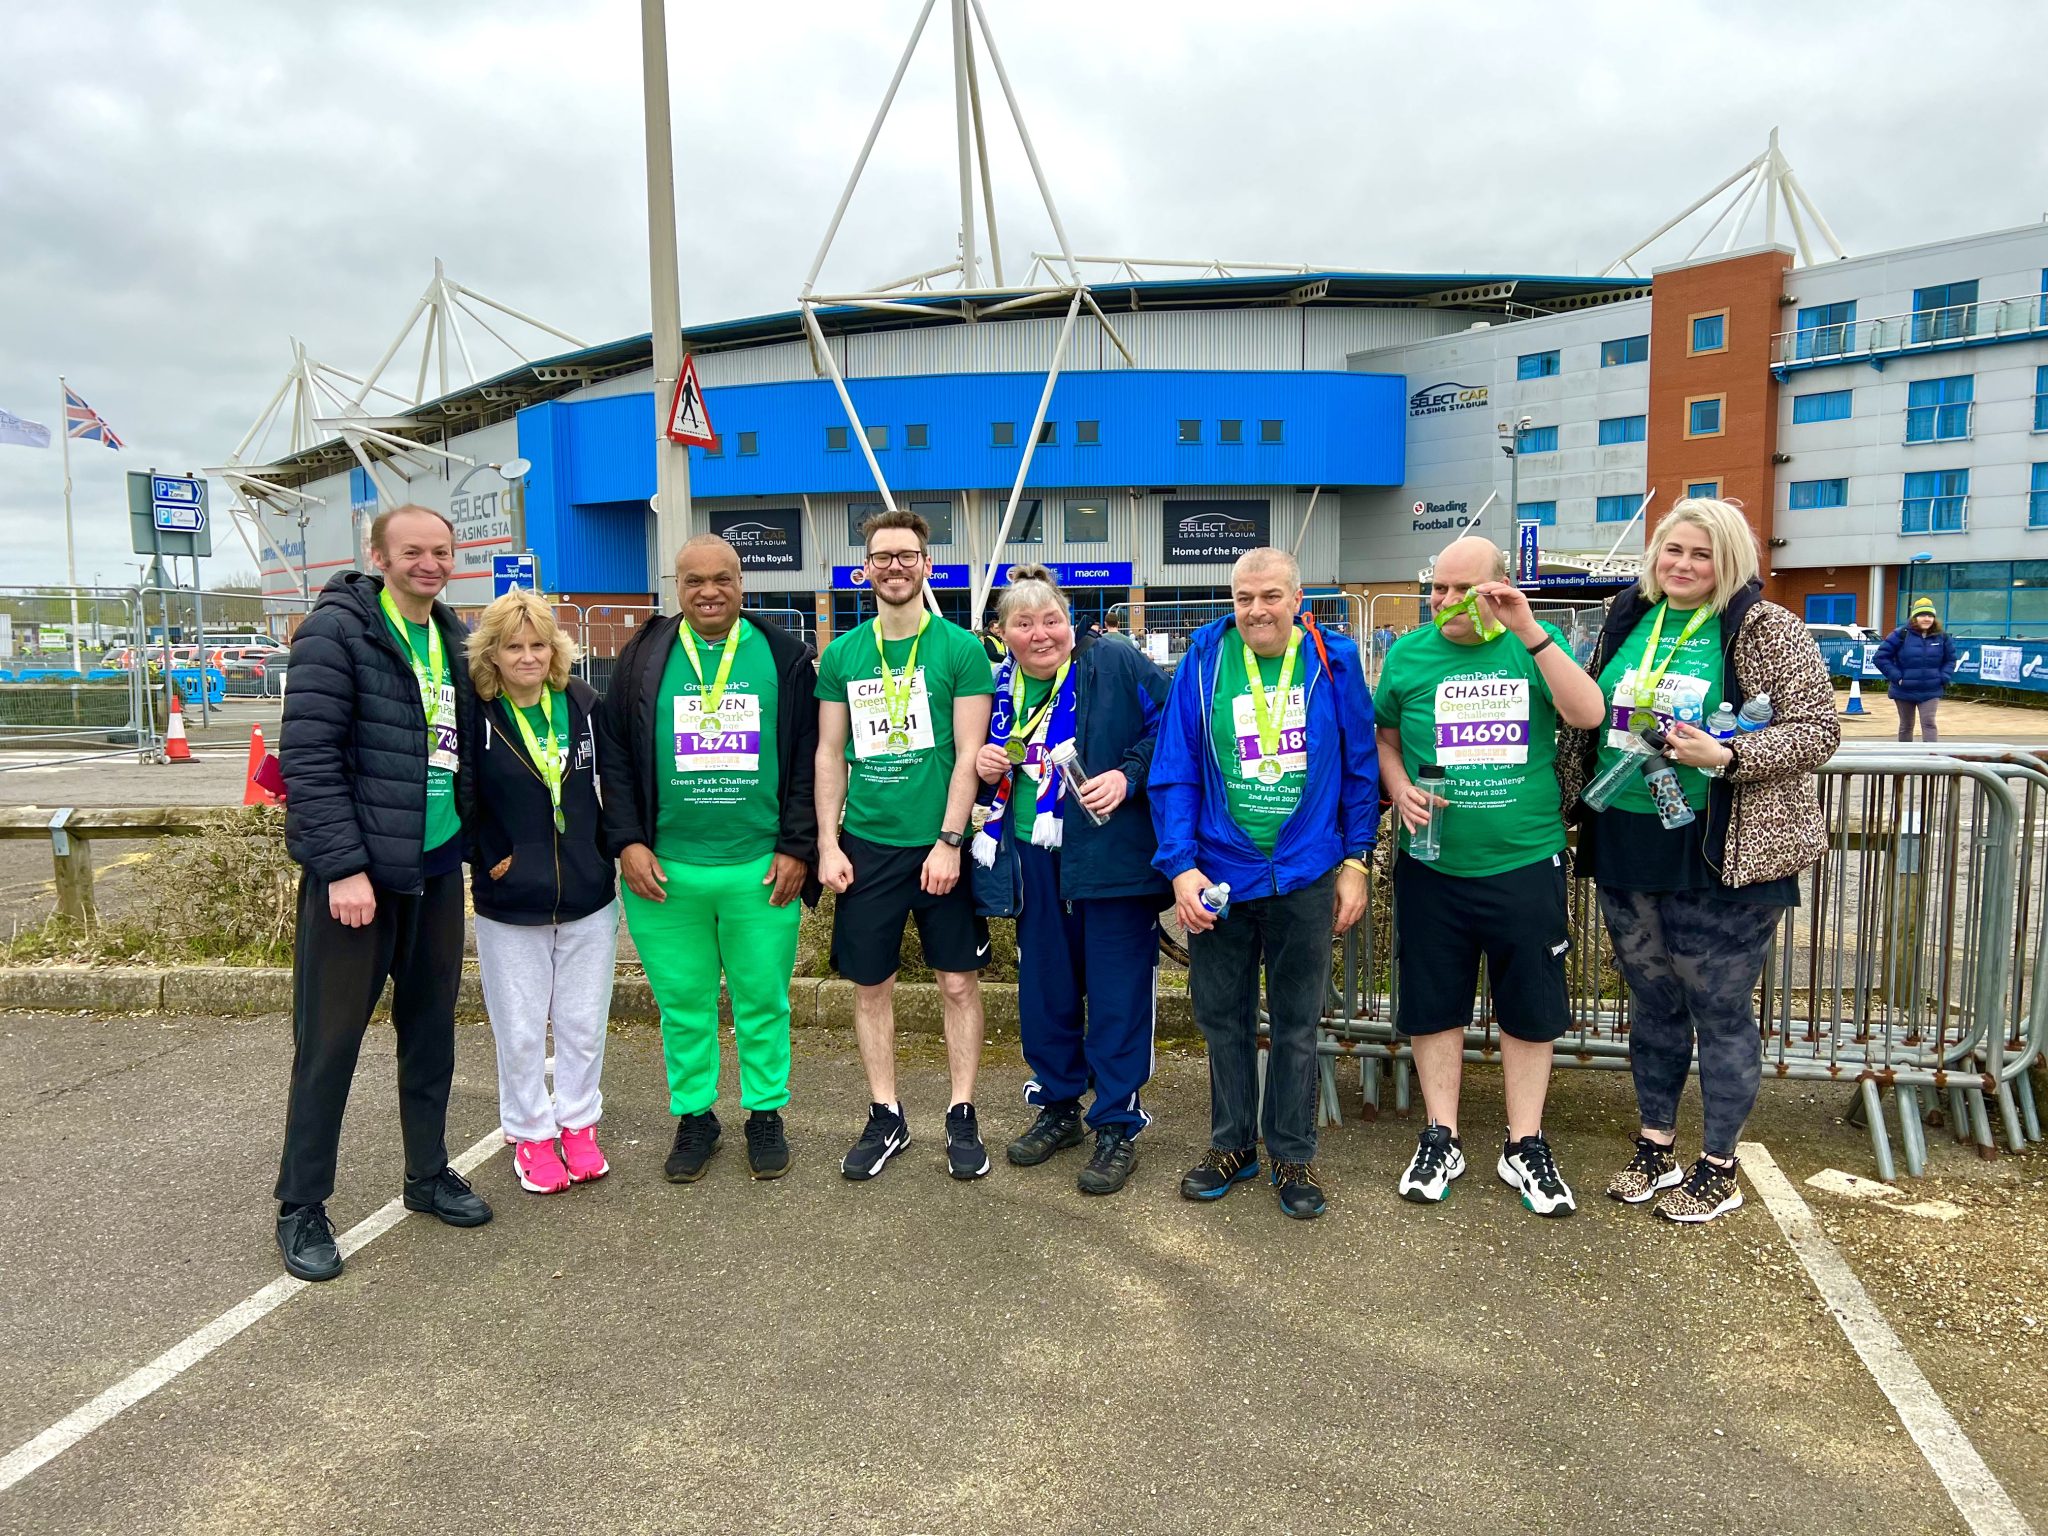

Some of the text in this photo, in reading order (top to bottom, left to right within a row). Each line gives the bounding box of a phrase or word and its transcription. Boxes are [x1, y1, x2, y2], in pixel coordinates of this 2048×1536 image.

[1410, 389, 1488, 409] SELECT CAR
[1410, 400, 1488, 416] LEASING STADIUM
[451, 492, 498, 524] SELECT
[1426, 501, 1467, 513] Reading
[1179, 523, 1256, 532] SELECT CAR
[1412, 518, 1453, 531] Football
[456, 525, 489, 541] EASING
[722, 531, 786, 540] SELECT CAR
[1172, 547, 1200, 556] Home
[1202, 547, 1213, 556] of
[1214, 547, 1230, 556] the
[742, 554, 793, 564] of the Royals
[1525, 546, 1533, 573] ZONE
[929, 572, 949, 580] cron
[1075, 570, 1109, 578] macron
[1547, 577, 1555, 585] to
[1556, 577, 1585, 587] Reading
[1586, 575, 1616, 584] Football
[1984, 657, 2002, 669] HALF
[1444, 684, 1519, 699] CHASLEY
[688, 698, 746, 712] STVEN
[1440, 699, 1511, 712] GreenPark
[1457, 711, 1506, 720] Challenge
[1449, 723, 1521, 744] 14690
[691, 733, 747, 751] 14741
[671, 778, 695, 786] Green
[719, 777, 760, 786] Challenge
[1226, 781, 1252, 791] Green
[1254, 784, 1275, 793] Park
[1459, 779, 1481, 787] Park
[1483, 776, 1526, 787] Challenge
[1263, 795, 1281, 803] April
[1469, 789, 1489, 797] April
